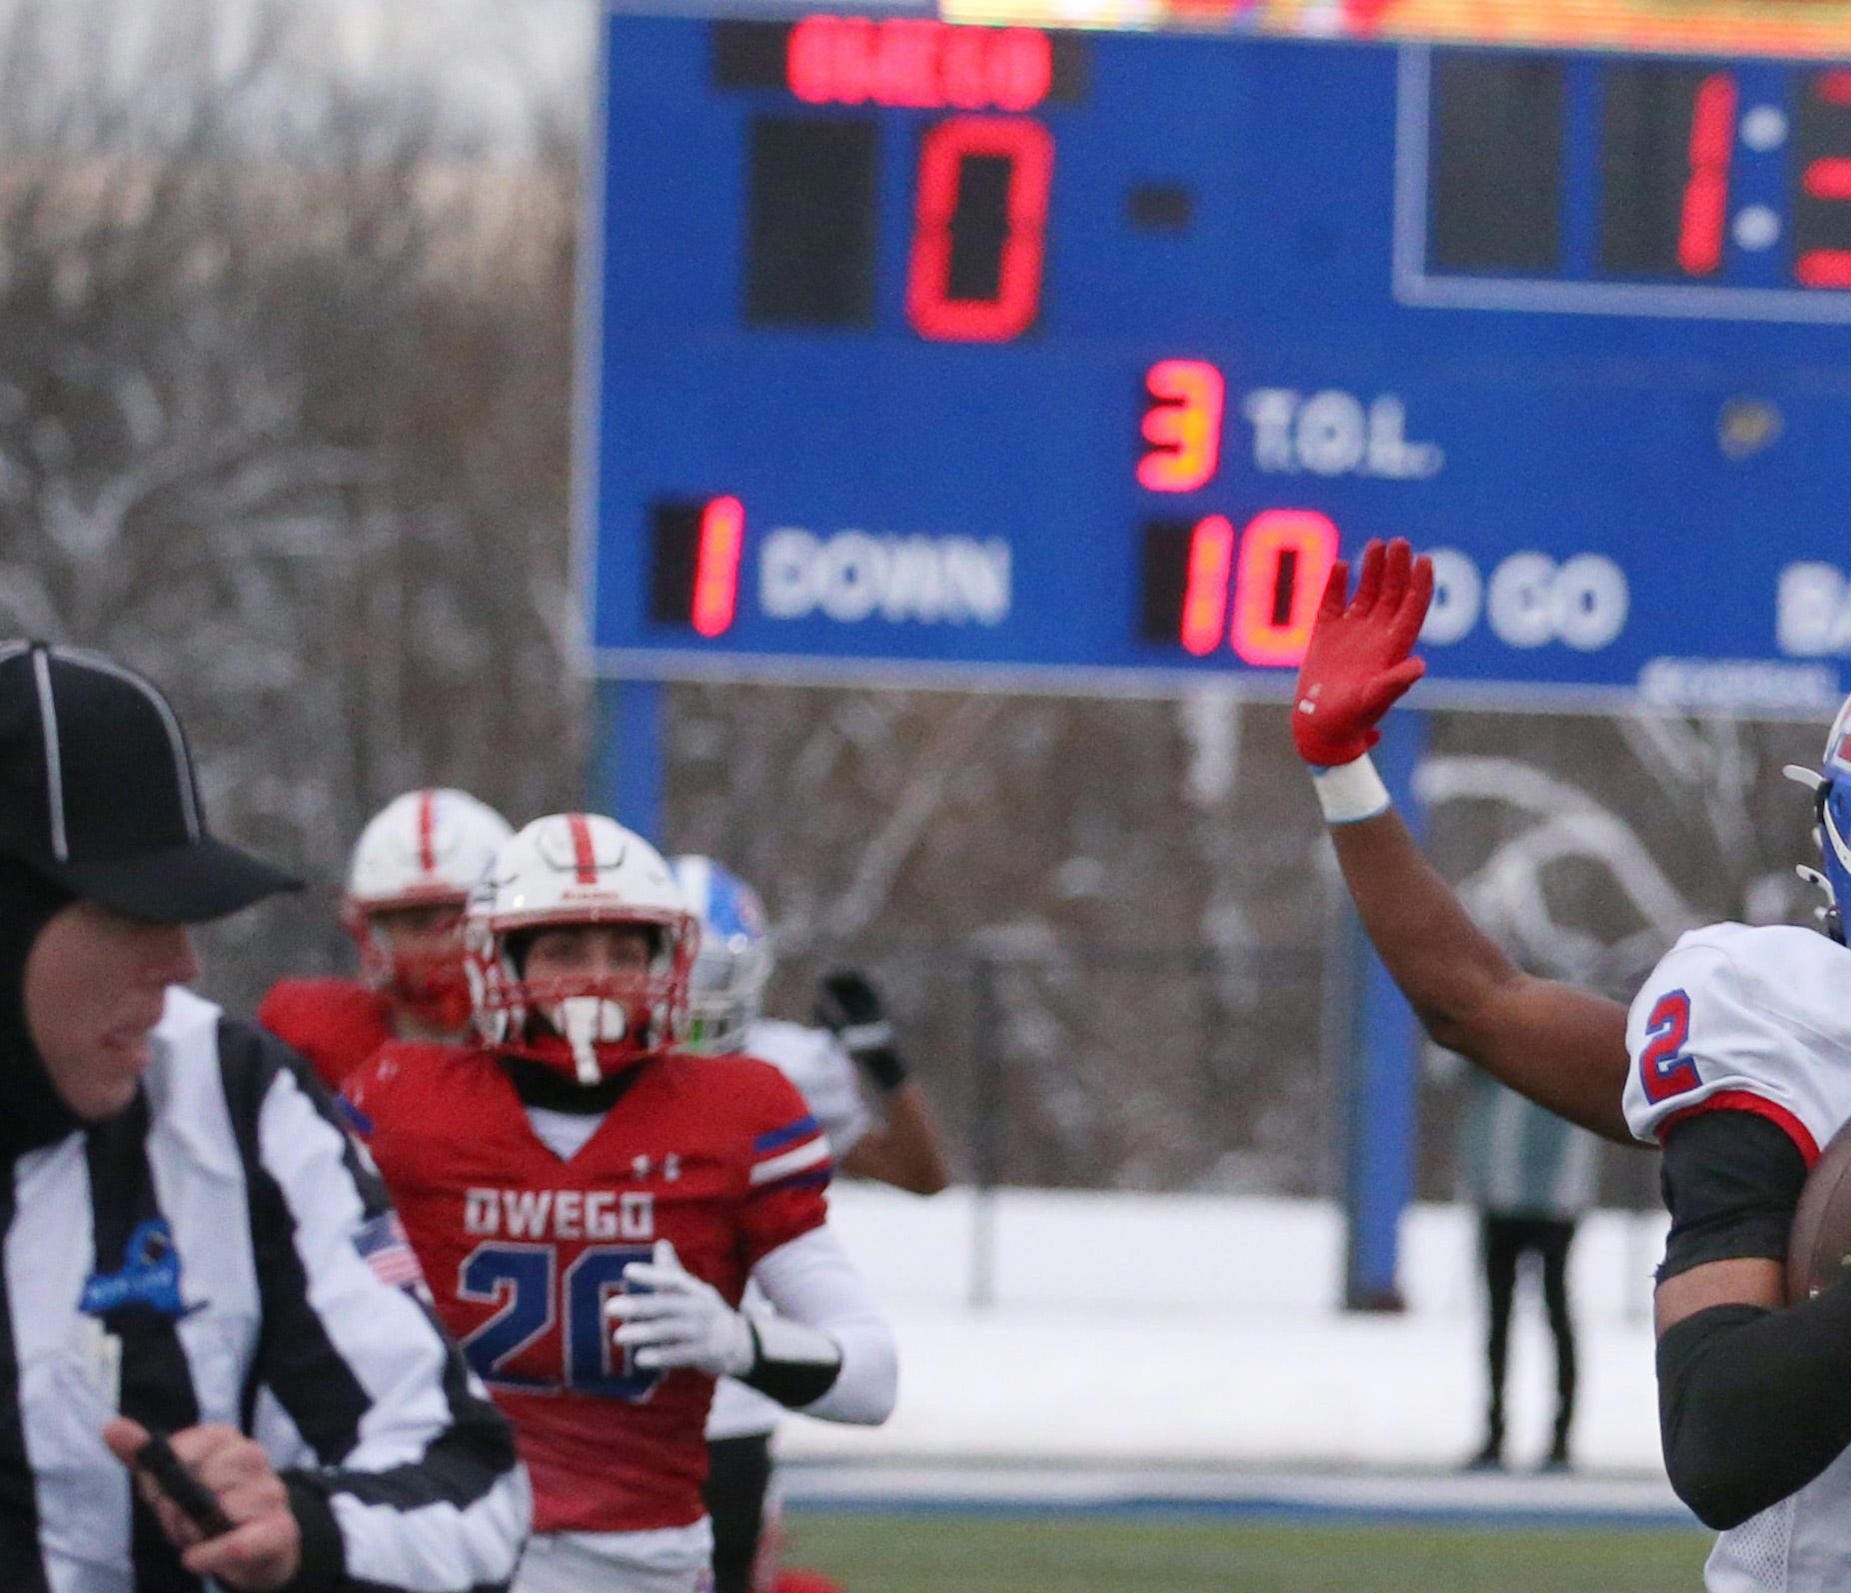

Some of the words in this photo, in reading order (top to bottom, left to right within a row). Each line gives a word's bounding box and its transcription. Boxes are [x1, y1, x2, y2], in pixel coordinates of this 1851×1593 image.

[907, 116, 1054, 343] 0
[1137, 359, 1225, 492] 3
[692, 496, 745, 637] 1
[758, 527, 1012, 625] DOWN
[1181, 510, 1340, 668] 10
[1488, 549, 1630, 651] GO
[1640, 987, 1702, 1107] 2
[464, 1187, 655, 1240] OWEGO
